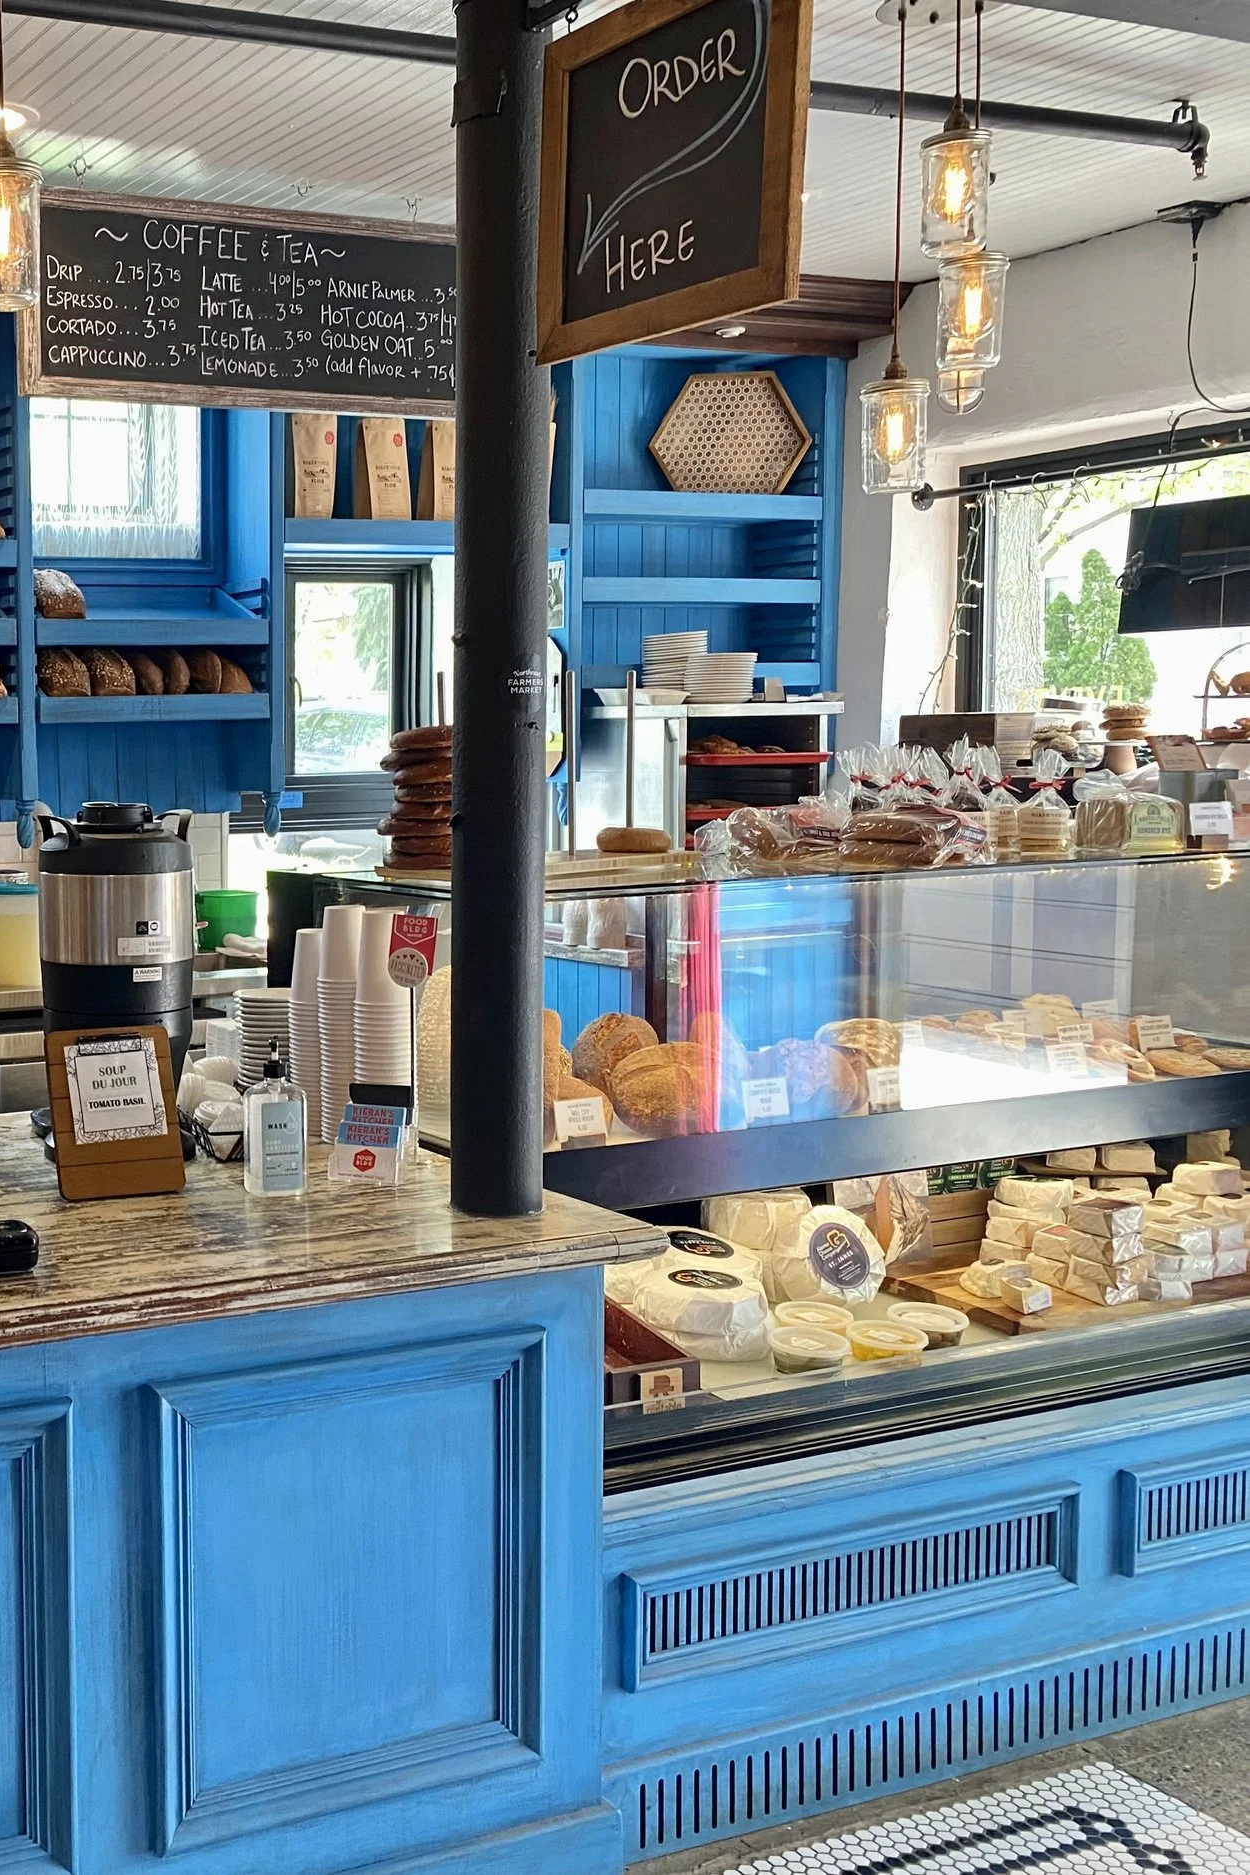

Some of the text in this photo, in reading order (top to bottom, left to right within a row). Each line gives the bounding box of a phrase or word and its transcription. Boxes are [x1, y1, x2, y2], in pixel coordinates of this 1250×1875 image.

[618, 28, 746, 119] ORDER
[143, 219, 250, 262] COFFEE
[46, 254, 83, 281] DRIP
[606, 220, 695, 294] HERE
[202, 265, 243, 293] LATTE
[327, 278, 416, 303] ARNIE PALMER
[200, 295, 254, 321] HOT TEA
[320, 304, 405, 333] HOT COCOA
[198, 325, 240, 350] ICED
[241, 327, 266, 351] TEA
[321, 329, 379, 352] GOLDEN
[384, 336, 415, 359] OAT
[201, 350, 279, 378] LEMONADE
[508, 678, 544, 686] FARMERS
[510, 686, 542, 694] MARKET
[403, 917, 428, 925] FOOD
[403, 925, 428, 933] BLDG
[92, 1076, 137, 1090] DU JOUR
[98, 1064, 127, 1076] SOUP
[88, 1097, 146, 1109] TOMATO BASIL
[346, 1133, 390, 1145] KITCHEN
